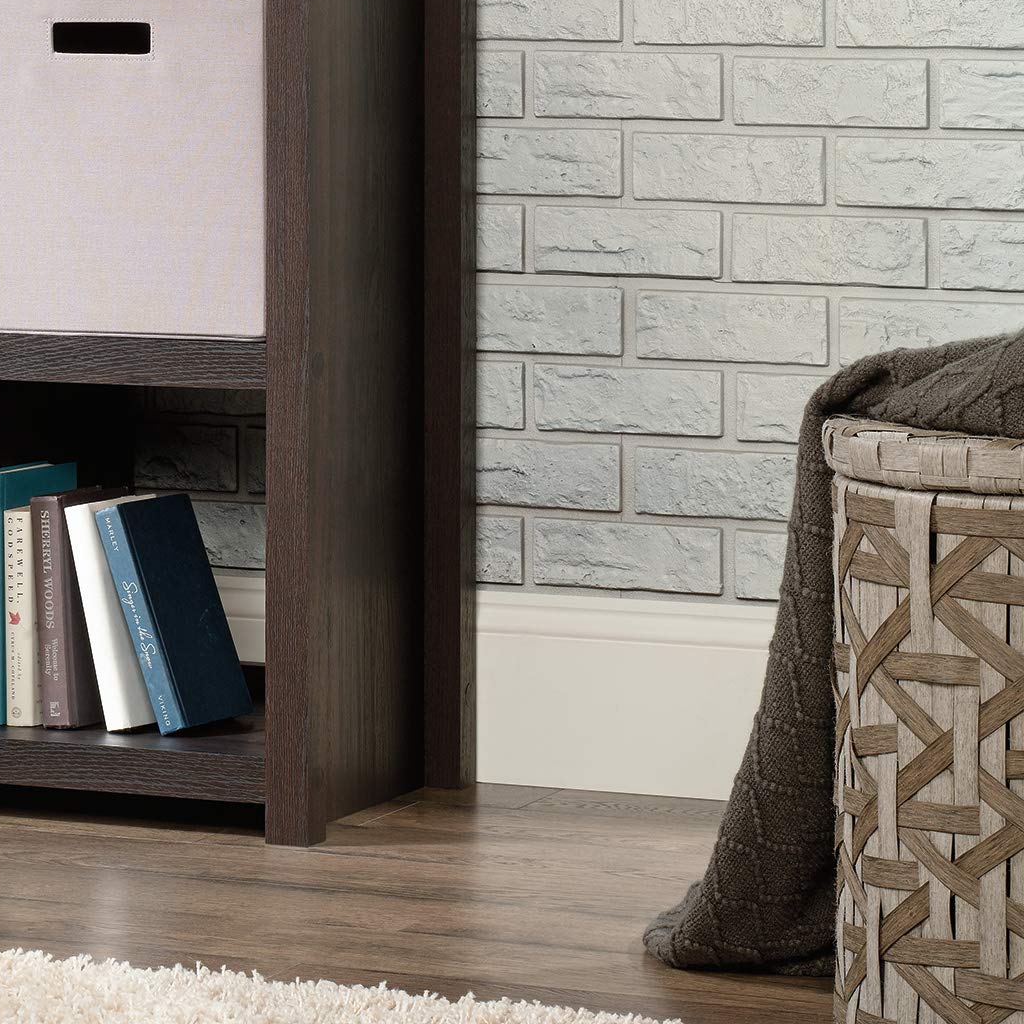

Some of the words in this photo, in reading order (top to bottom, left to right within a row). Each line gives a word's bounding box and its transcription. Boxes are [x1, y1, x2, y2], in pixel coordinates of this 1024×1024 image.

[41, 510, 52, 574] SHERRYL
[105, 517, 119, 552] MARLEY
[43, 577, 55, 629] WOODS
[137, 626, 152, 641] the
[140, 642, 156, 669] Snow
[158, 695, 171, 726] VIKING
